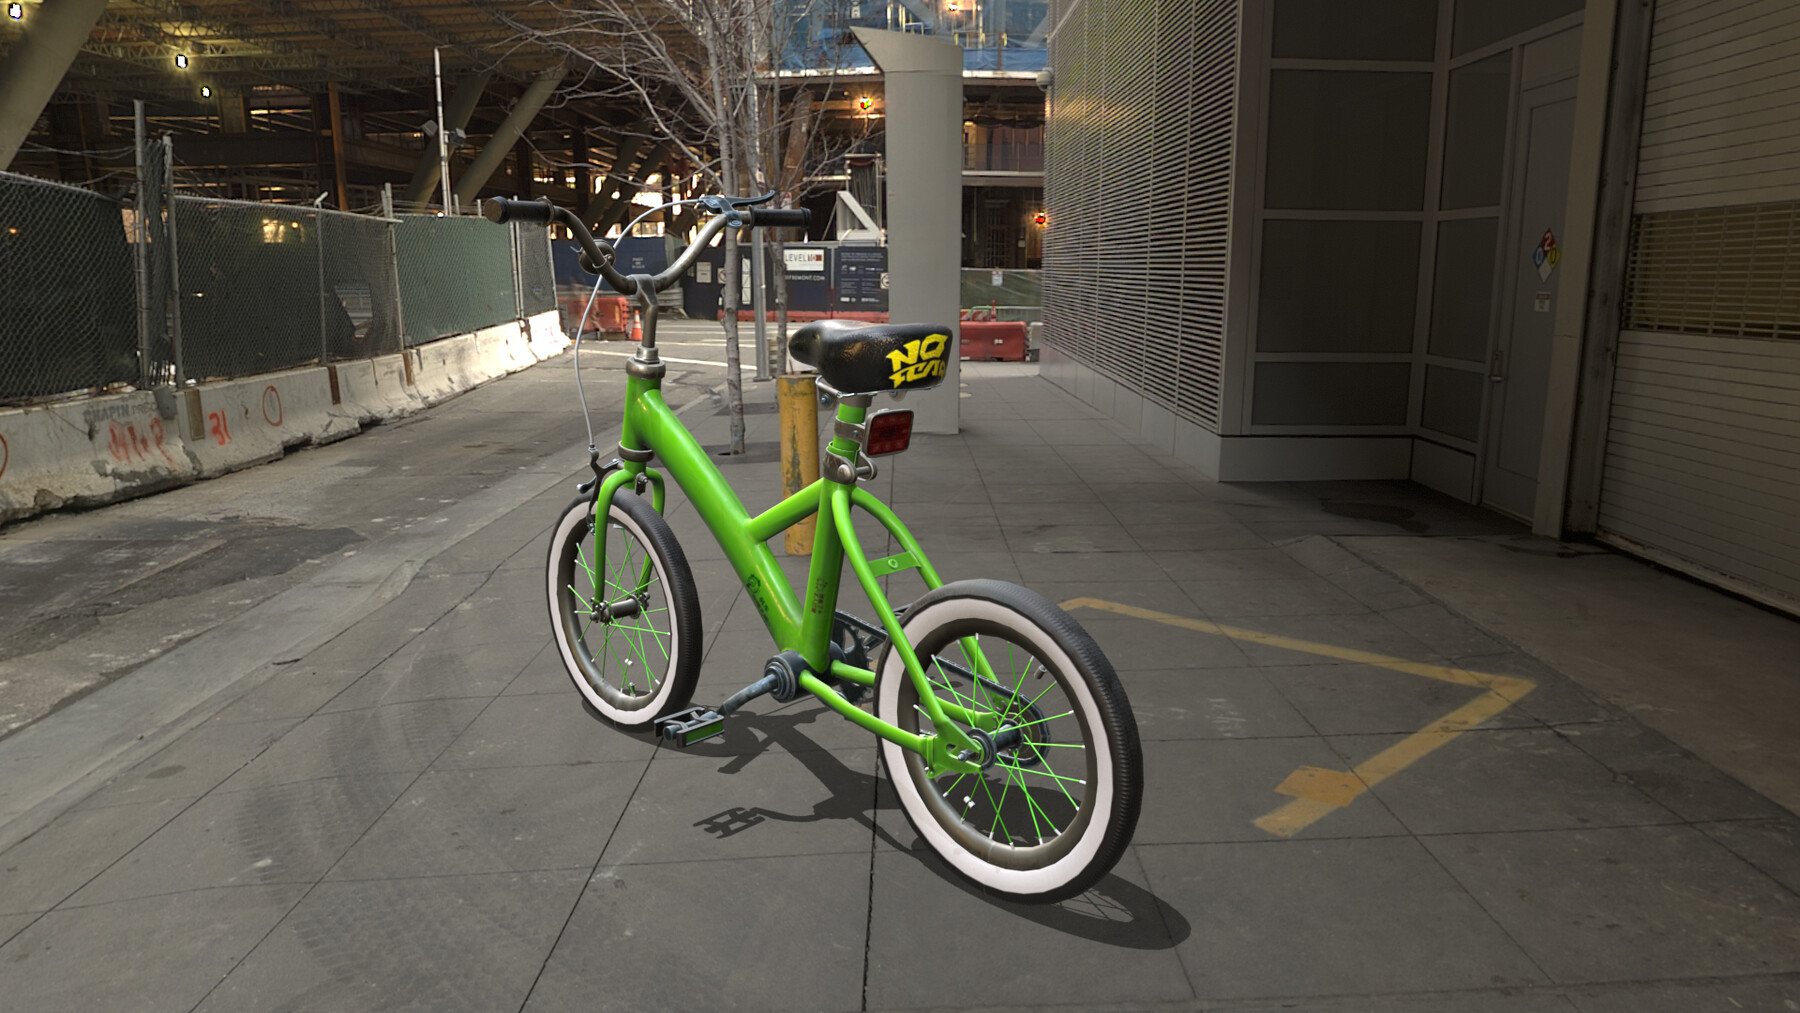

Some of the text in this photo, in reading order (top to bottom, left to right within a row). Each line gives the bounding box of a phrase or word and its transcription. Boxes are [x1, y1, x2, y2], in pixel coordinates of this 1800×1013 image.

[1545, 232, 1552, 251] 2
[1536, 247, 1544, 265] 0
[1550, 247, 1557, 264] 0
[886, 333, 948, 372] NO
[888, 359, 946, 389] FEAR
[208, 408, 233, 446] 31
